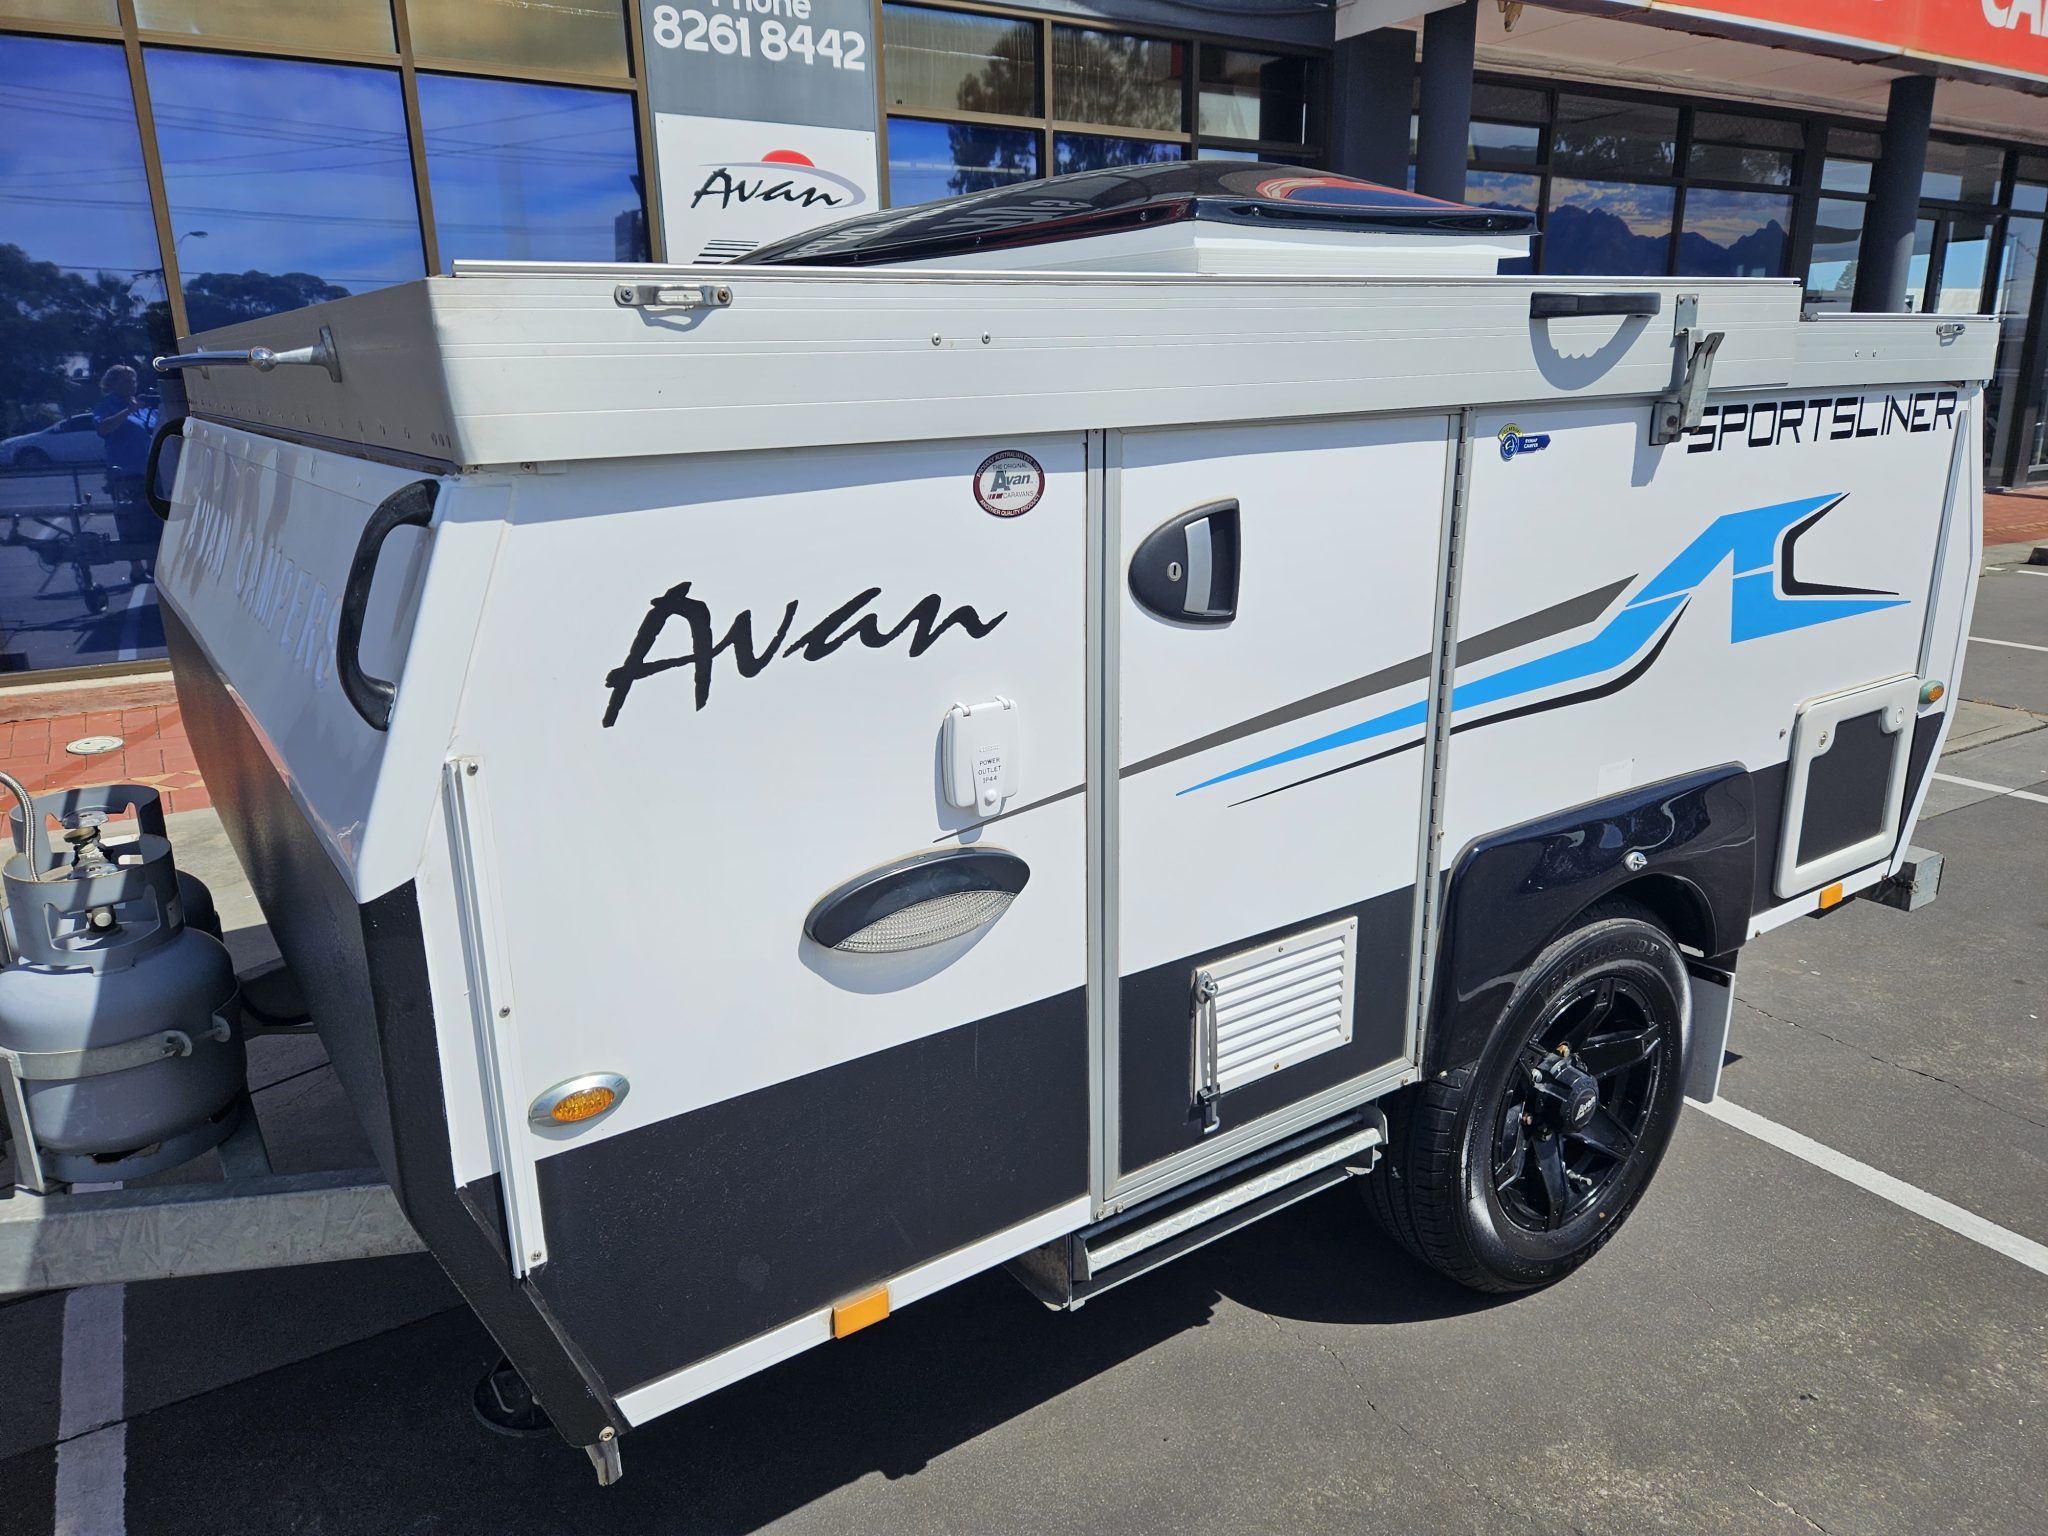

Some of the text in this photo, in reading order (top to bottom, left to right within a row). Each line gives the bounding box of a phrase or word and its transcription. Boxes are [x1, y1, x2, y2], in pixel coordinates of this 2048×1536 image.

[712, 0, 812, 20] one
[653, 5, 866, 72] 8261 8442
[690, 167, 843, 209] Avan
[1687, 391, 1958, 454] SPORTSLINER
[1003, 462, 1028, 470] ORIGINAL
[1003, 490, 1034, 499] CARAVANS
[980, 500, 1001, 515] ANOTHER
[1020, 495, 1041, 513] PRODUCT
[602, 581, 1008, 729] Avan
[978, 765, 1001, 775] OUTLET
[979, 757, 1000, 766] POWER
